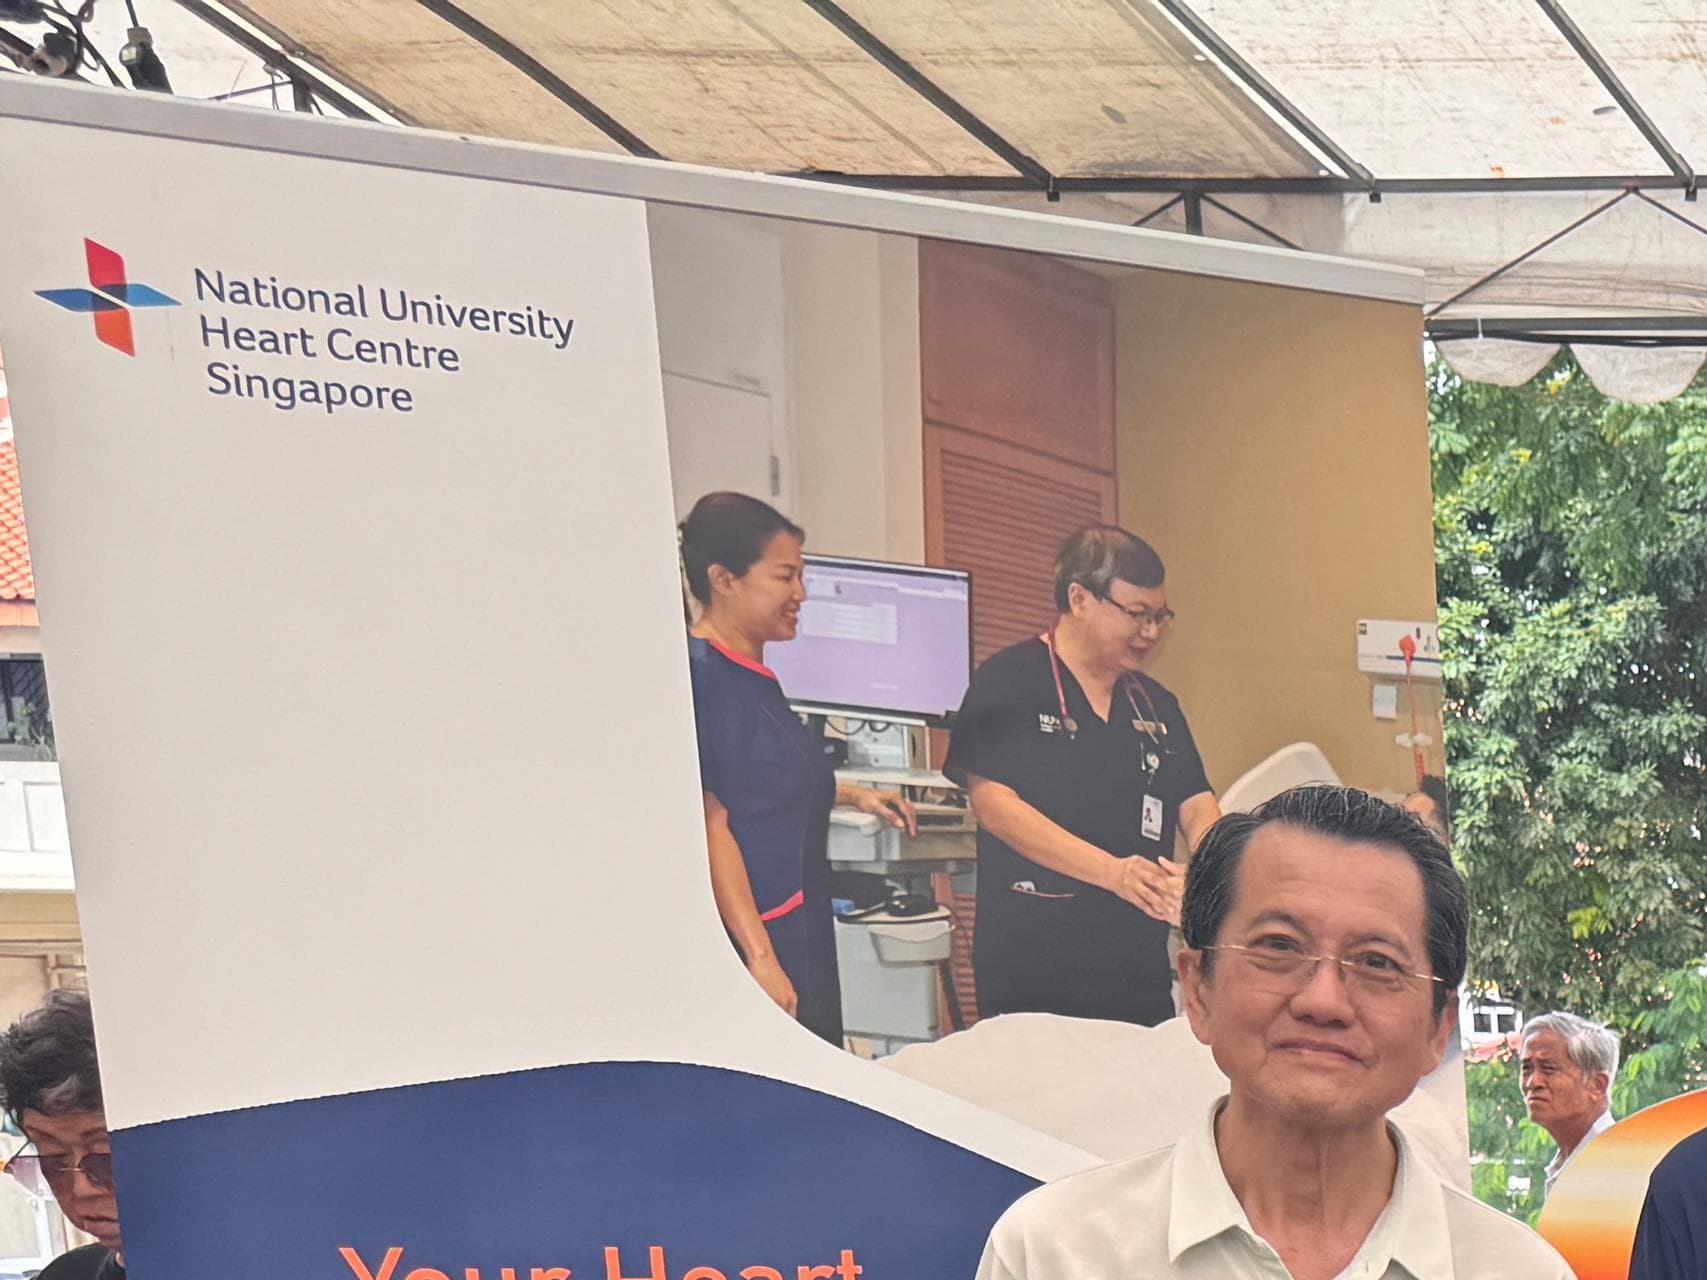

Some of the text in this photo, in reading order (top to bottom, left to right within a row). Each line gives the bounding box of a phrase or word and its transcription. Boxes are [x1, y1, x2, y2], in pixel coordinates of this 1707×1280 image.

[194, 268, 575, 349] National University
[200, 314, 461, 371] Heart Centre
[207, 362, 414, 413] Singapore
